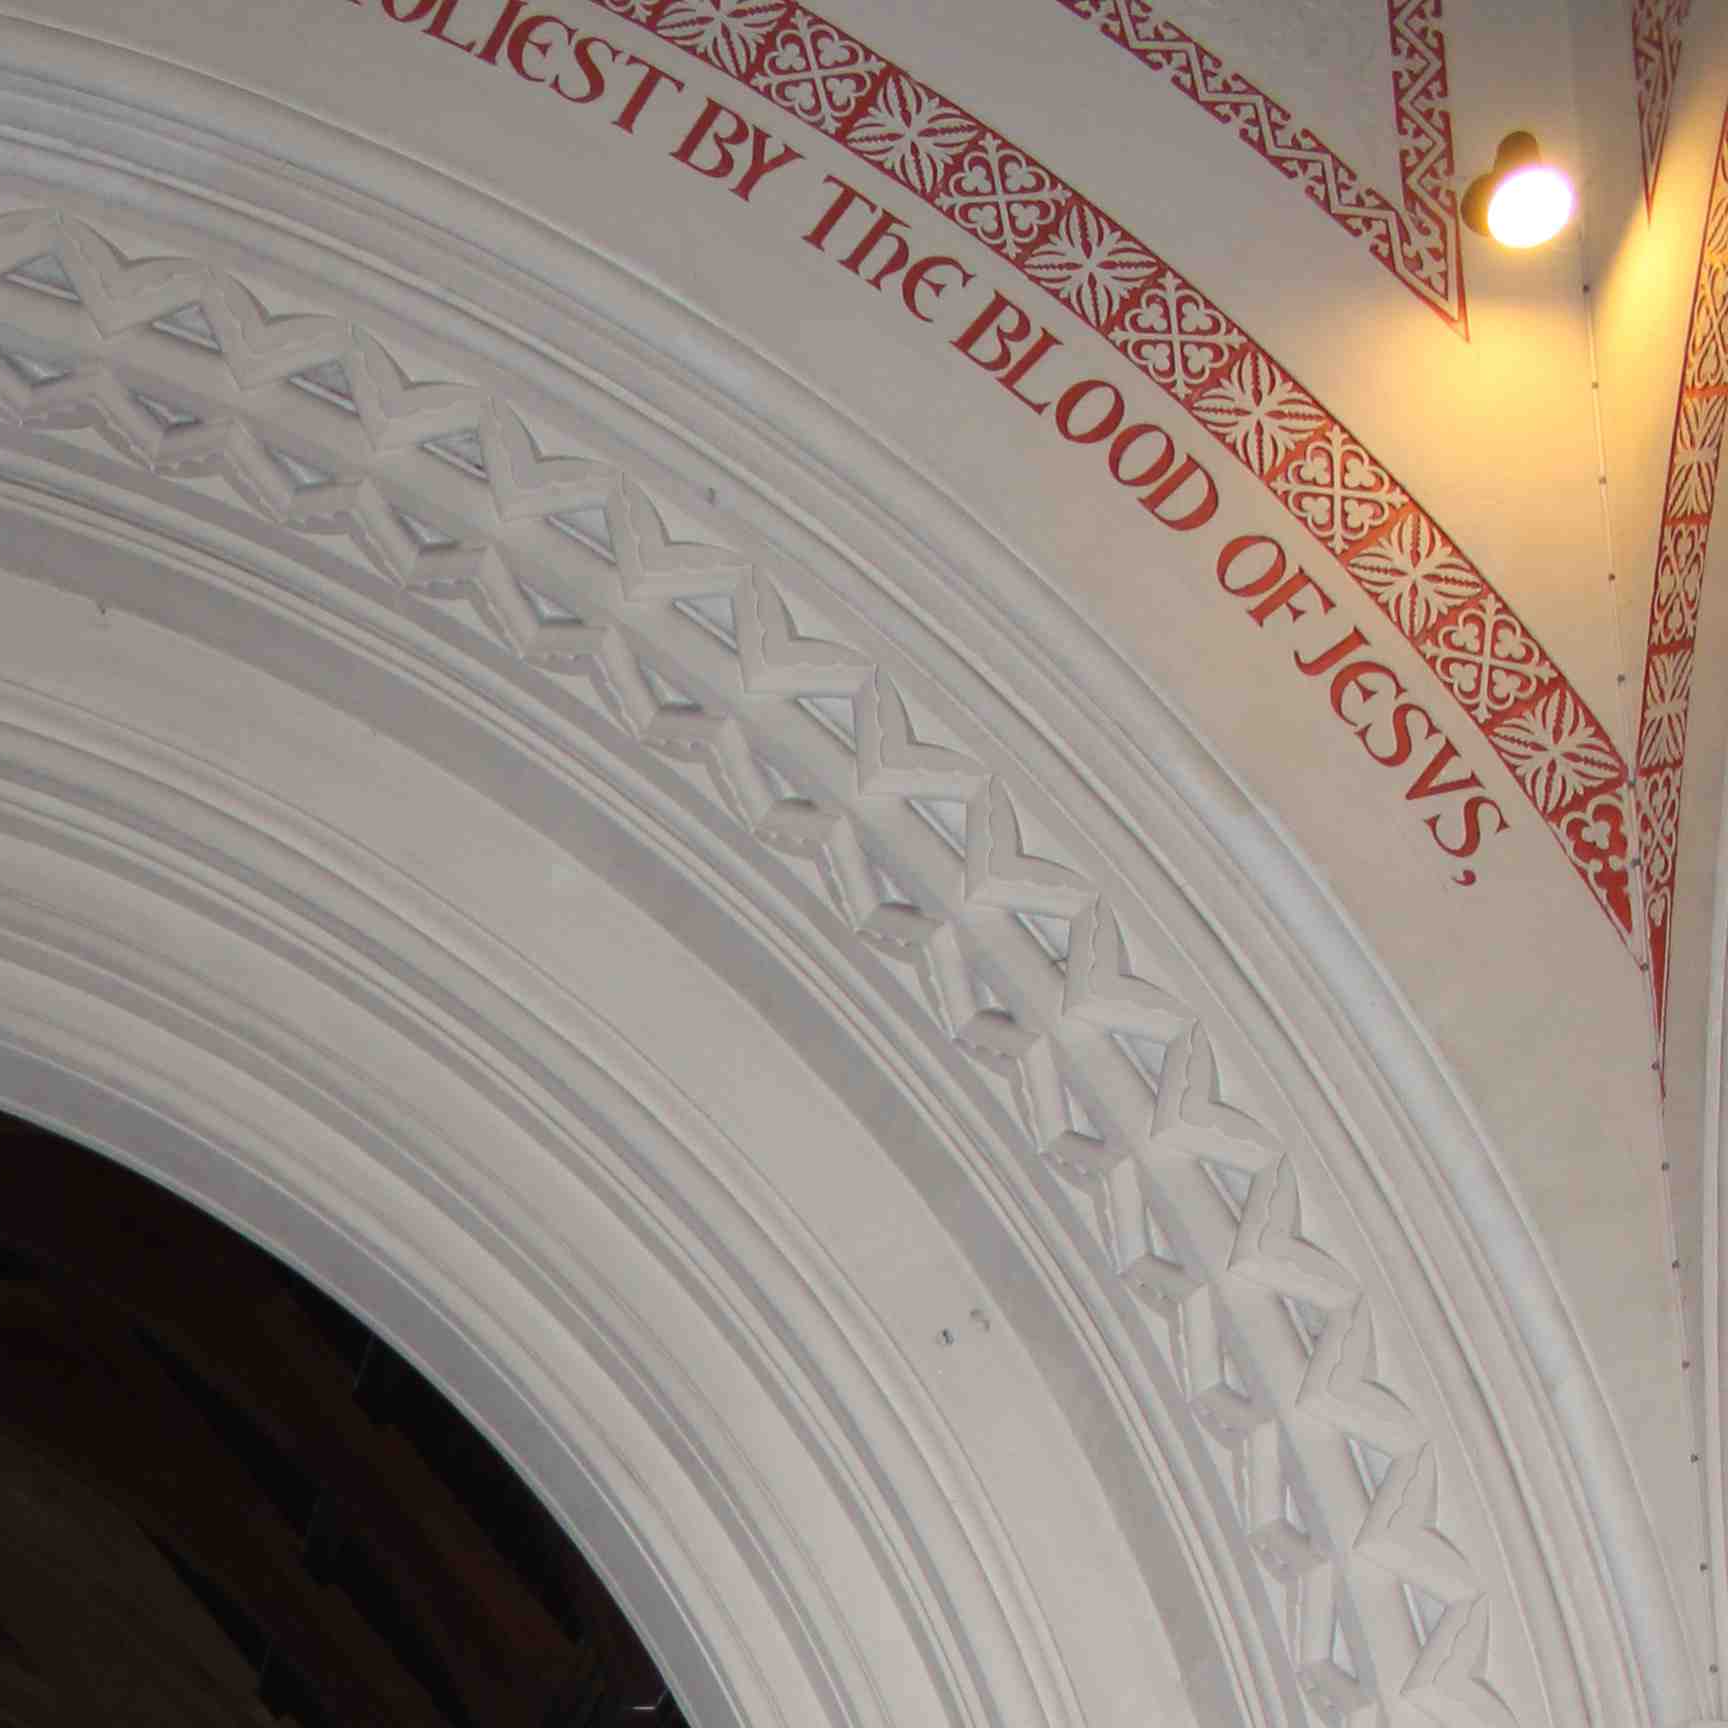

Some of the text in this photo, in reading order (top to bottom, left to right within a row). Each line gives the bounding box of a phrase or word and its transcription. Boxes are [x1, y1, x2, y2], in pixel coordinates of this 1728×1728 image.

[670, 97, 804, 202] BY
[951, 289, 1220, 533] BLOOD
[1215, 533, 1336, 629] OF
